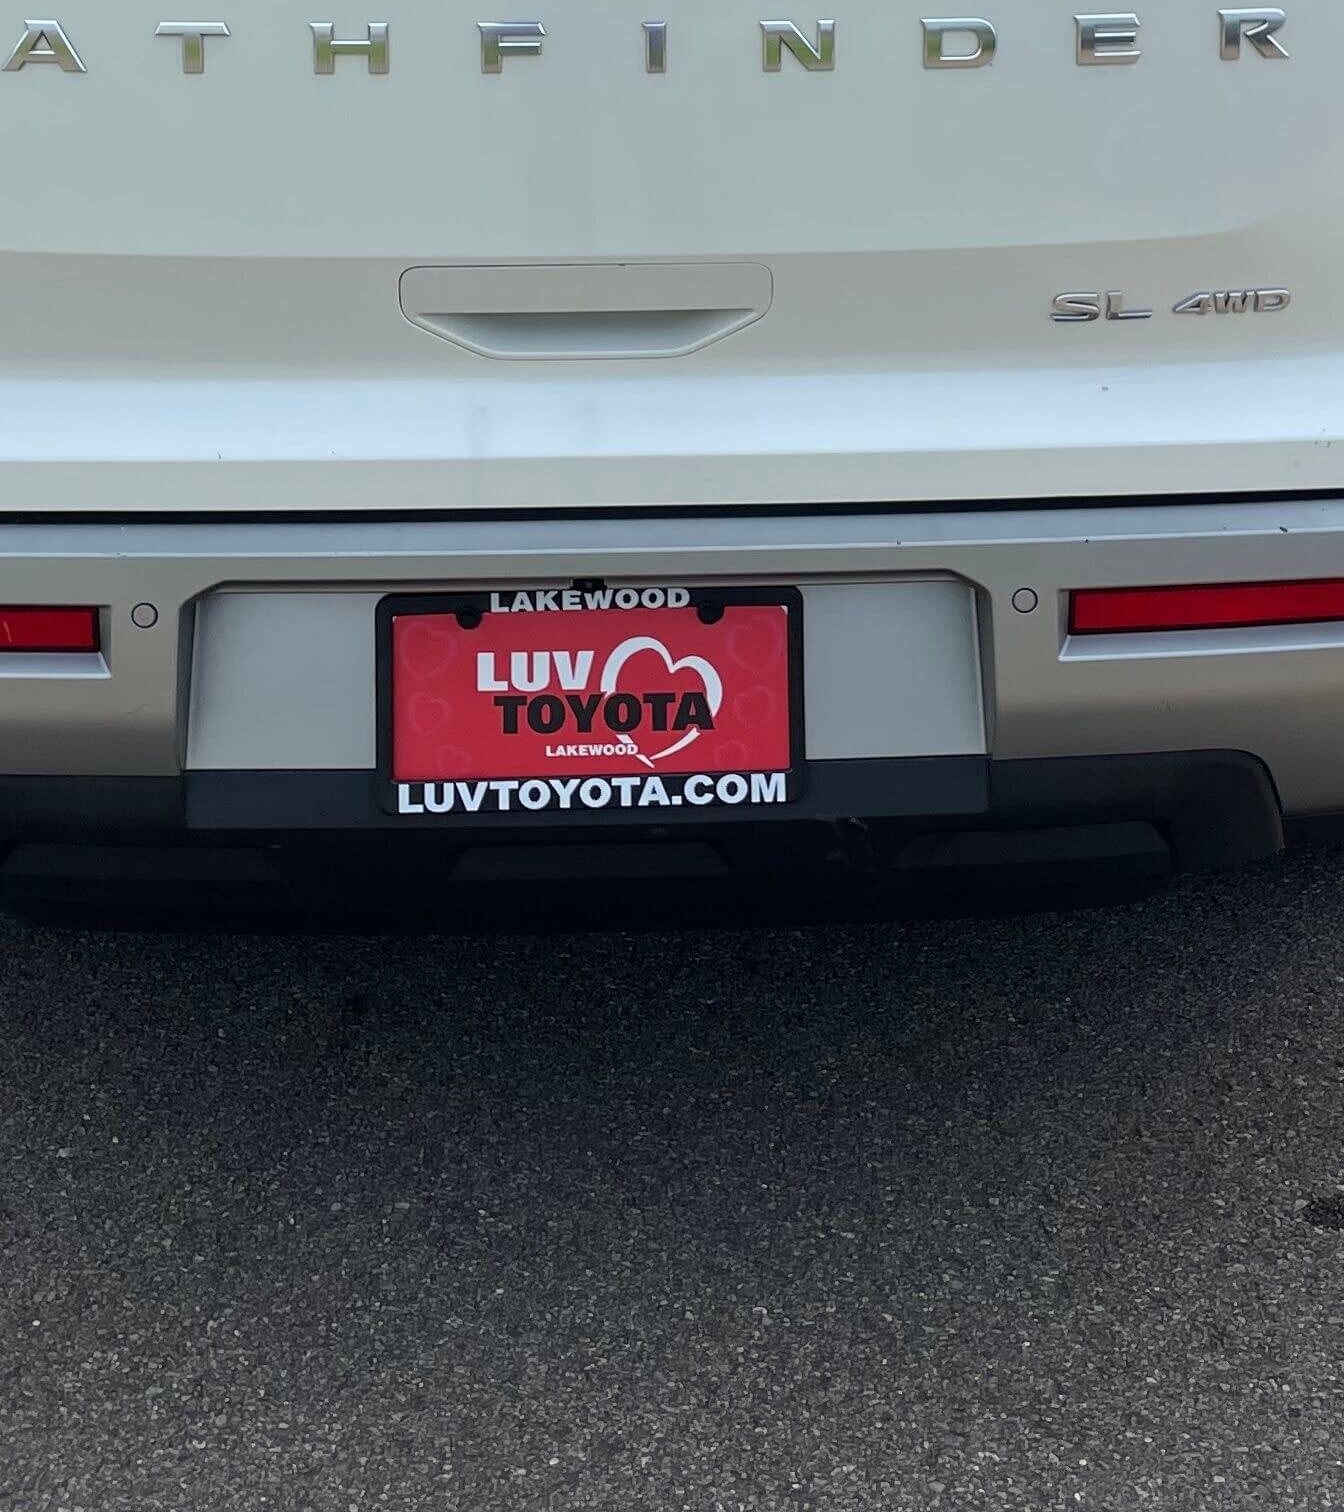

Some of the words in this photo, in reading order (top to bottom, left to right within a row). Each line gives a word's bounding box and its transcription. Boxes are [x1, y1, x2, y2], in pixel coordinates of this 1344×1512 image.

[1051, 290, 1153, 322] SL
[1171, 287, 1291, 315] 4WD
[489, 587, 691, 614] LAKEWOOD
[476, 650, 595, 692] LUV
[493, 691, 716, 735] TOYOTA
[545, 742, 639, 757] LAKEWOOD
[397, 772, 787, 814] LUVTOYOTA.COM
